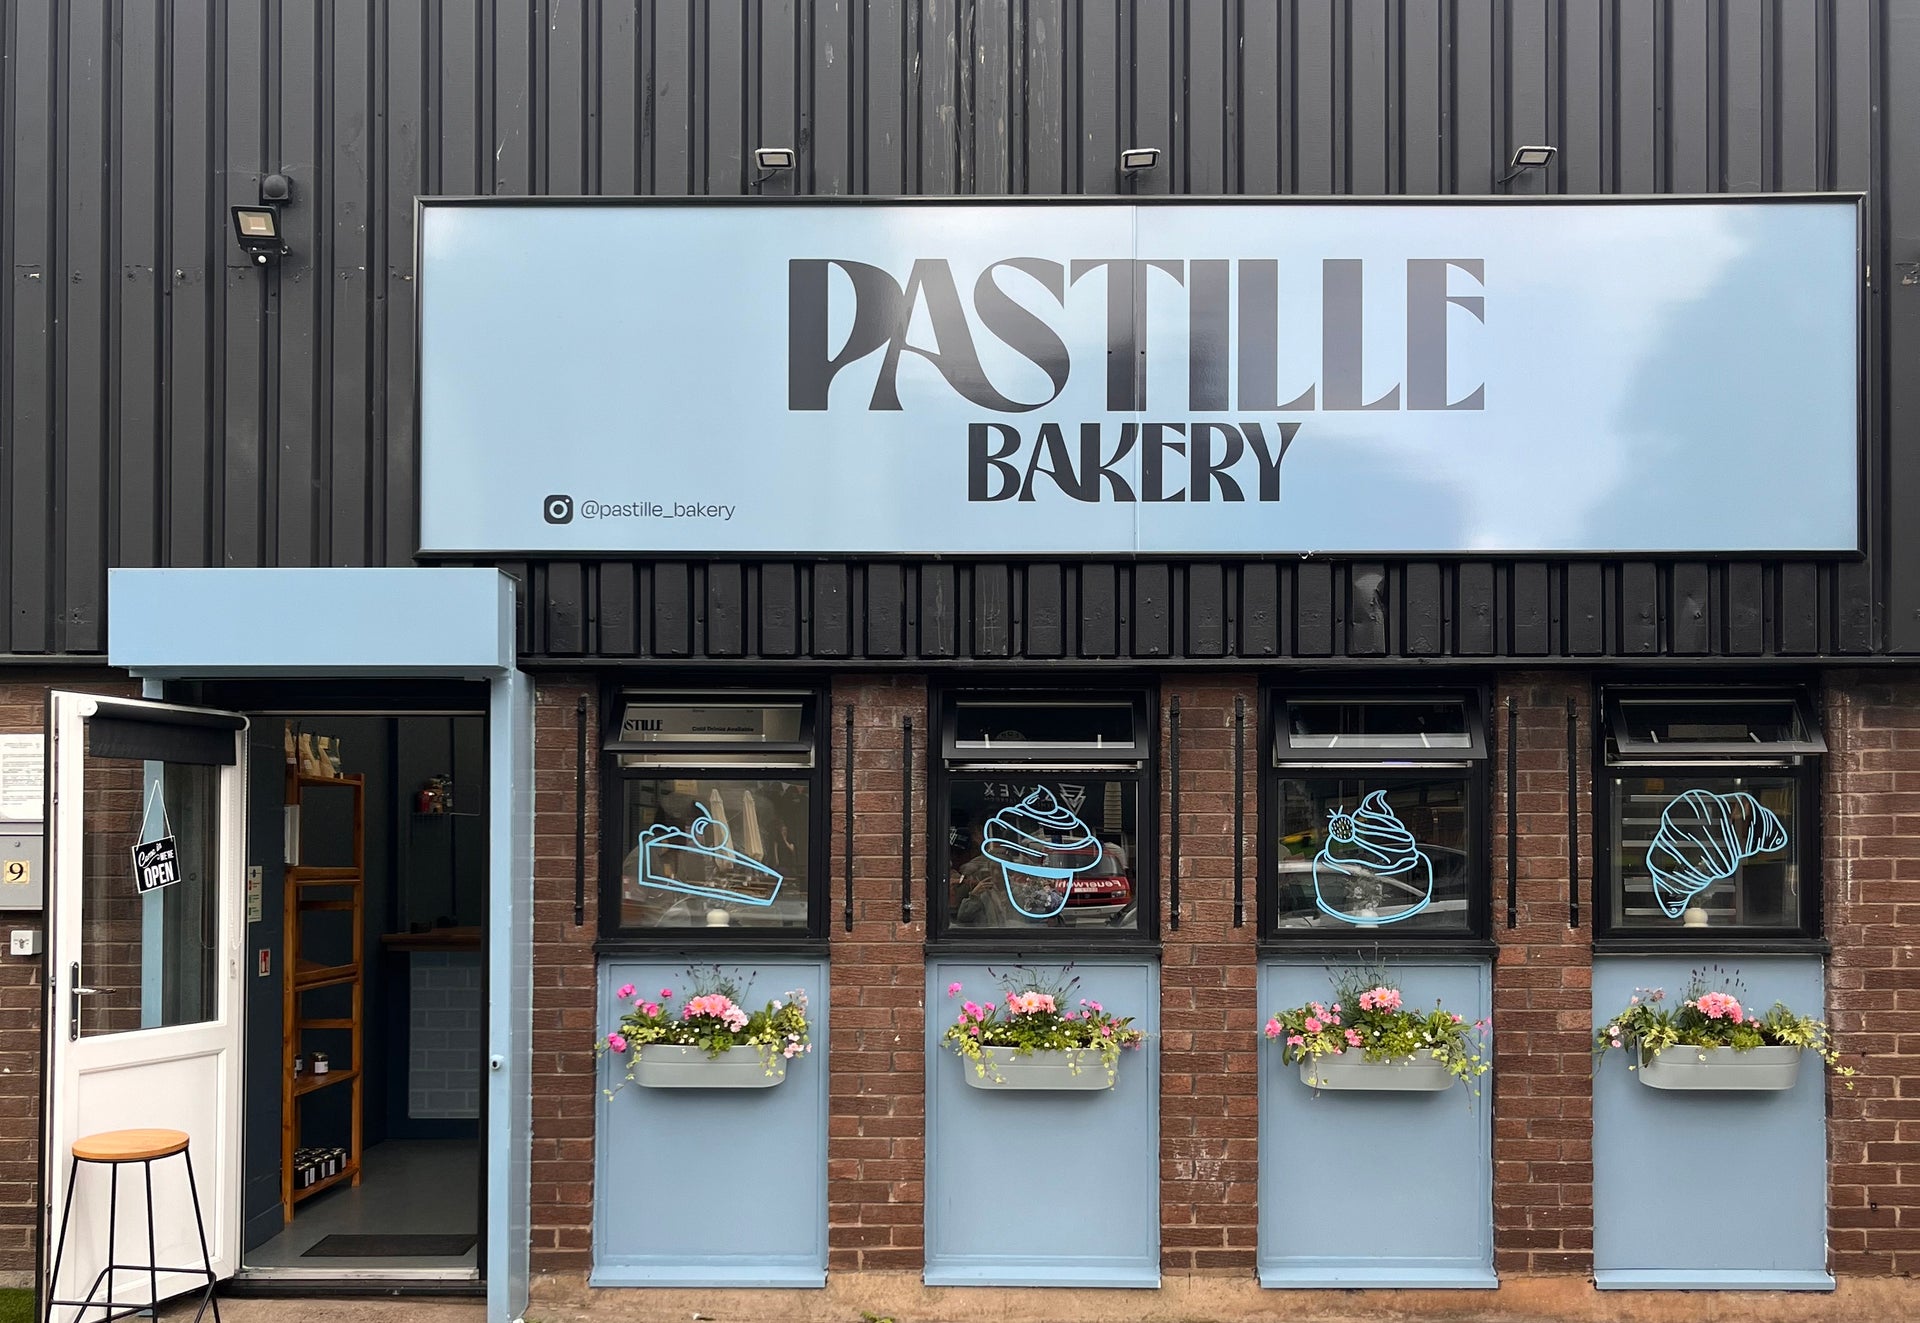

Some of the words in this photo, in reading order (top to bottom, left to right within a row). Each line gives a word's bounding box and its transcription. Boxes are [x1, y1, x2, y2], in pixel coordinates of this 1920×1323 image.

[788, 257, 1486, 413] PASTILLE
[967, 422, 1304, 502] BAKERY
[581, 499, 736, 521] @pastille_bakery
[624, 719, 663, 731] STILLE
[9, 862, 24, 881] 9
[143, 861, 175, 888] OPEN
